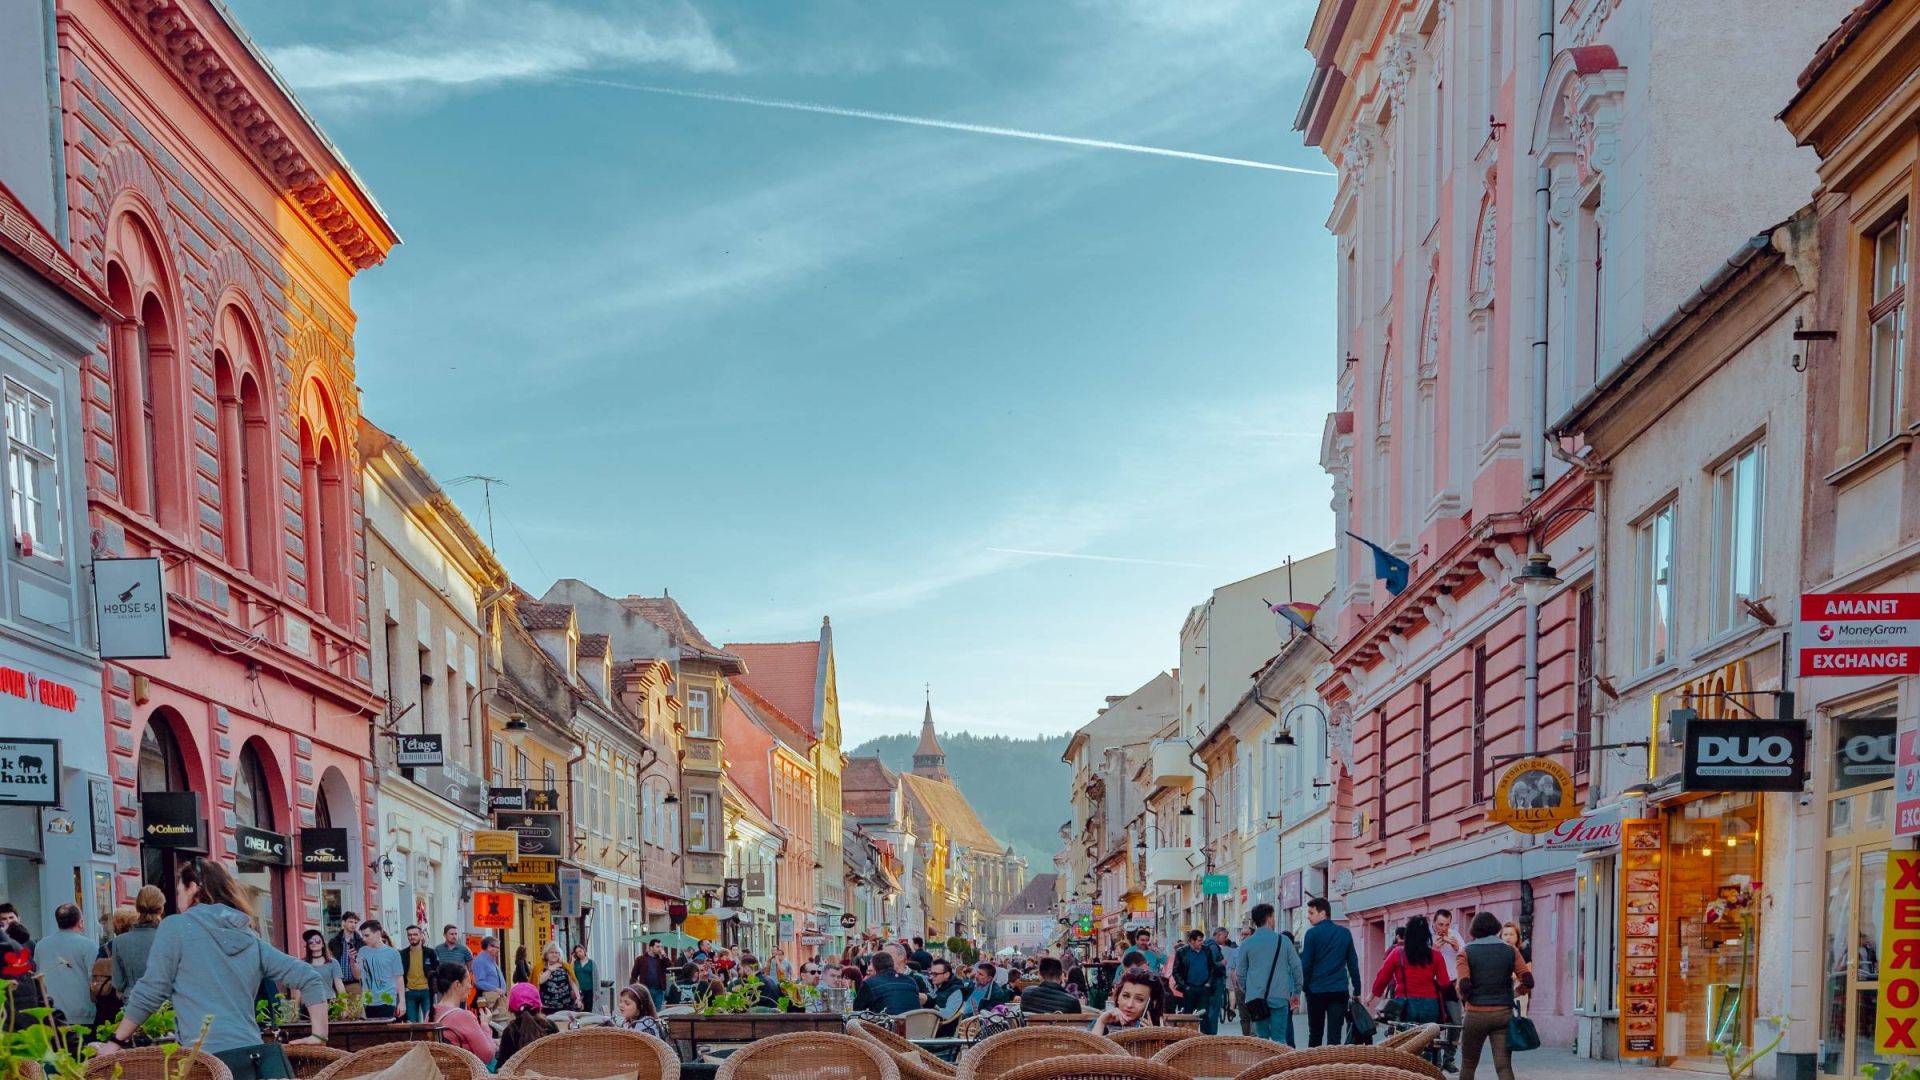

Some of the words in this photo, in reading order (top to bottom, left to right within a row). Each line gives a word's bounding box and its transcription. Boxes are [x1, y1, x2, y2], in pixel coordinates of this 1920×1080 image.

[104, 602, 140, 614] HOUSE
[144, 602, 156, 613] 54
[1825, 599, 1898, 615] AMANET
[1838, 624, 1907, 637] MoneyGram
[1813, 652, 1908, 669] EXCHANGE
[0, 666, 27, 699] OYAL
[1697, 735, 1793, 764] DUO
[1, 771, 48, 785] hant
[1515, 809, 1554, 819] LUCA
[156, 824, 194, 834] Columbia
